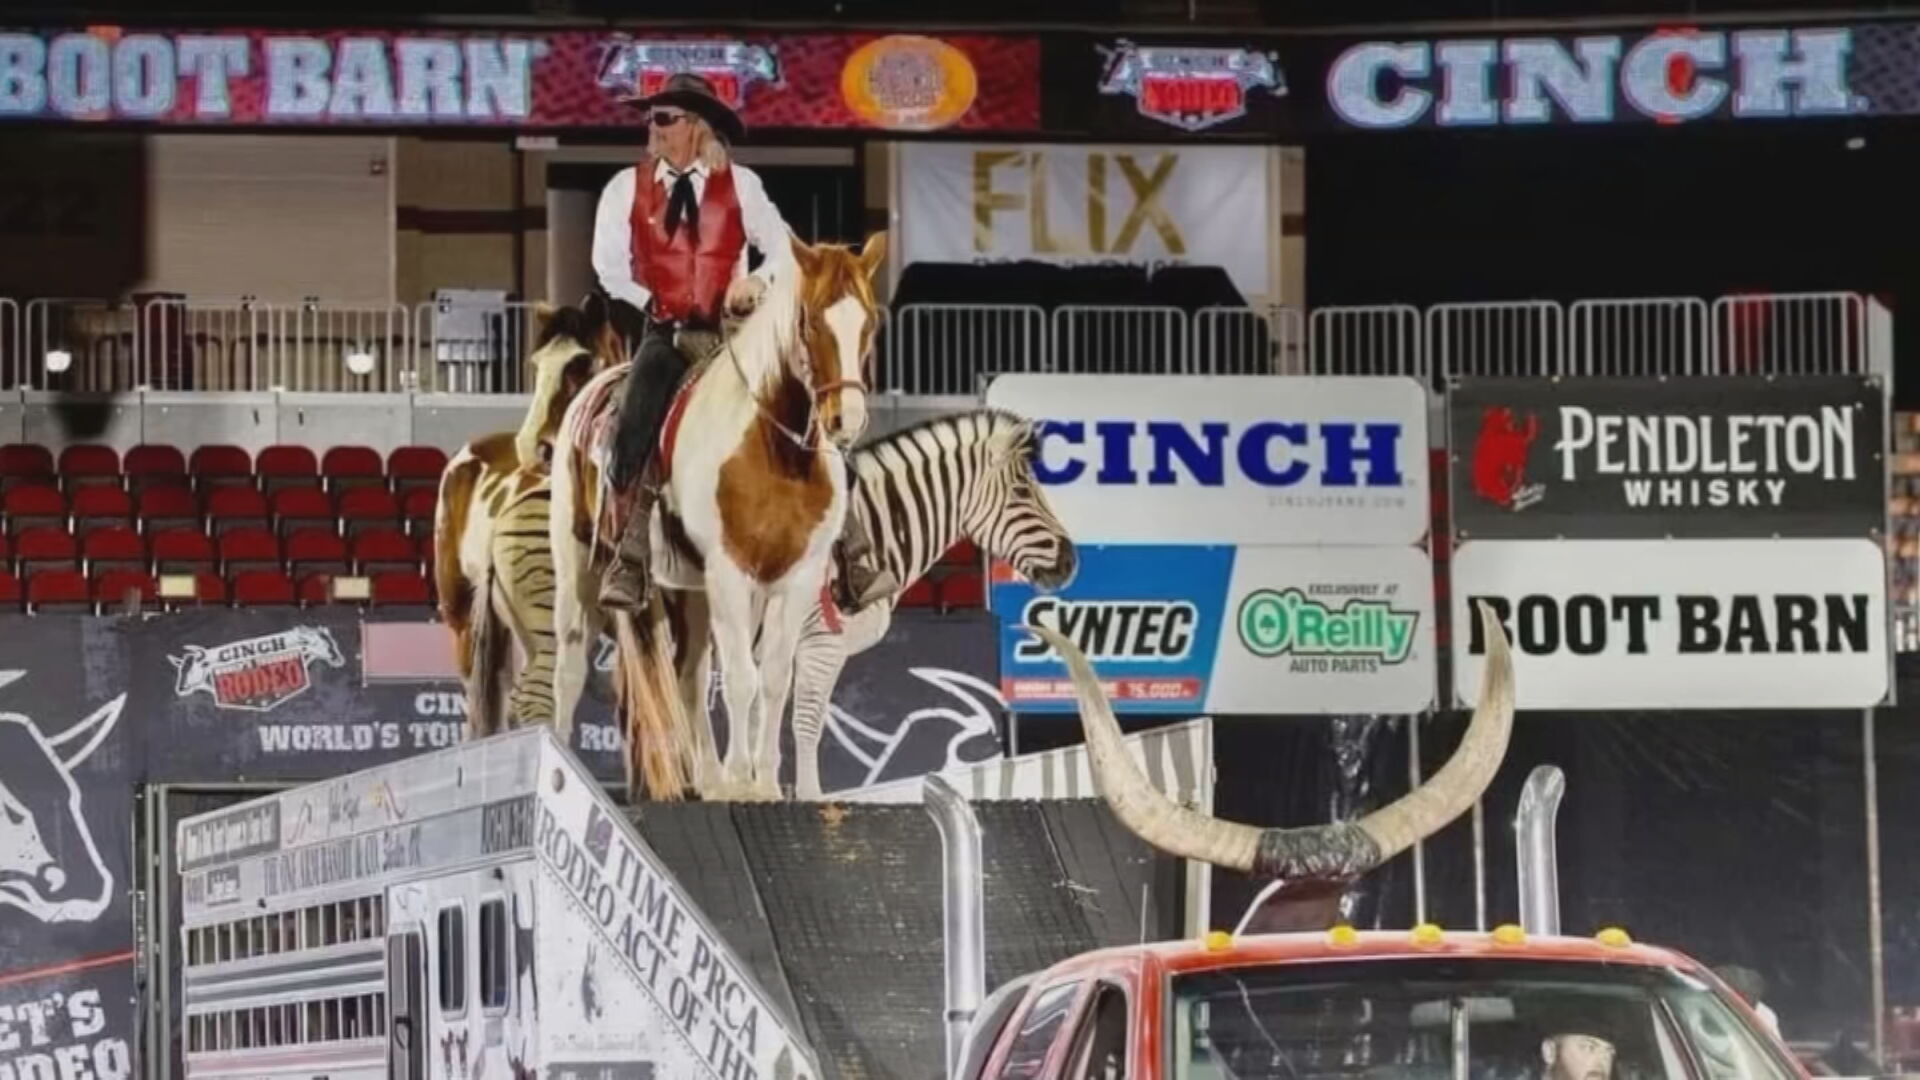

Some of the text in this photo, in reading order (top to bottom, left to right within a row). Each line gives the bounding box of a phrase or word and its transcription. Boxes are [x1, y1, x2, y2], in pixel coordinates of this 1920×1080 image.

[0, 33, 531, 118] BOOT BARN
[1327, 28, 1853, 128] CINCH
[974, 151, 1185, 255] FLIX
[1032, 420, 1402, 487] CINCH
[1554, 406, 1856, 480] PENDLETON
[1624, 480, 1787, 507] WHISKY
[1308, 583, 1399, 595] EXCLUSIVELY AT
[218, 637, 287, 663] CINCH
[1018, 600, 1195, 657] SYNTEC
[1242, 592, 1414, 660] O'Reilly
[1467, 594, 1870, 656] BOOT BARN
[218, 659, 301, 702] RODEO
[1289, 658, 1378, 674] AUTO PARTS
[414, 692, 467, 715] CIN
[258, 720, 400, 752] WORLD'S
[538, 805, 616, 927] RODEO
[615, 912, 669, 989] ACT
[668, 975, 704, 1035] OF
[617, 838, 759, 1056] TIME PRCA
[0, 1037, 131, 1080] DEO
